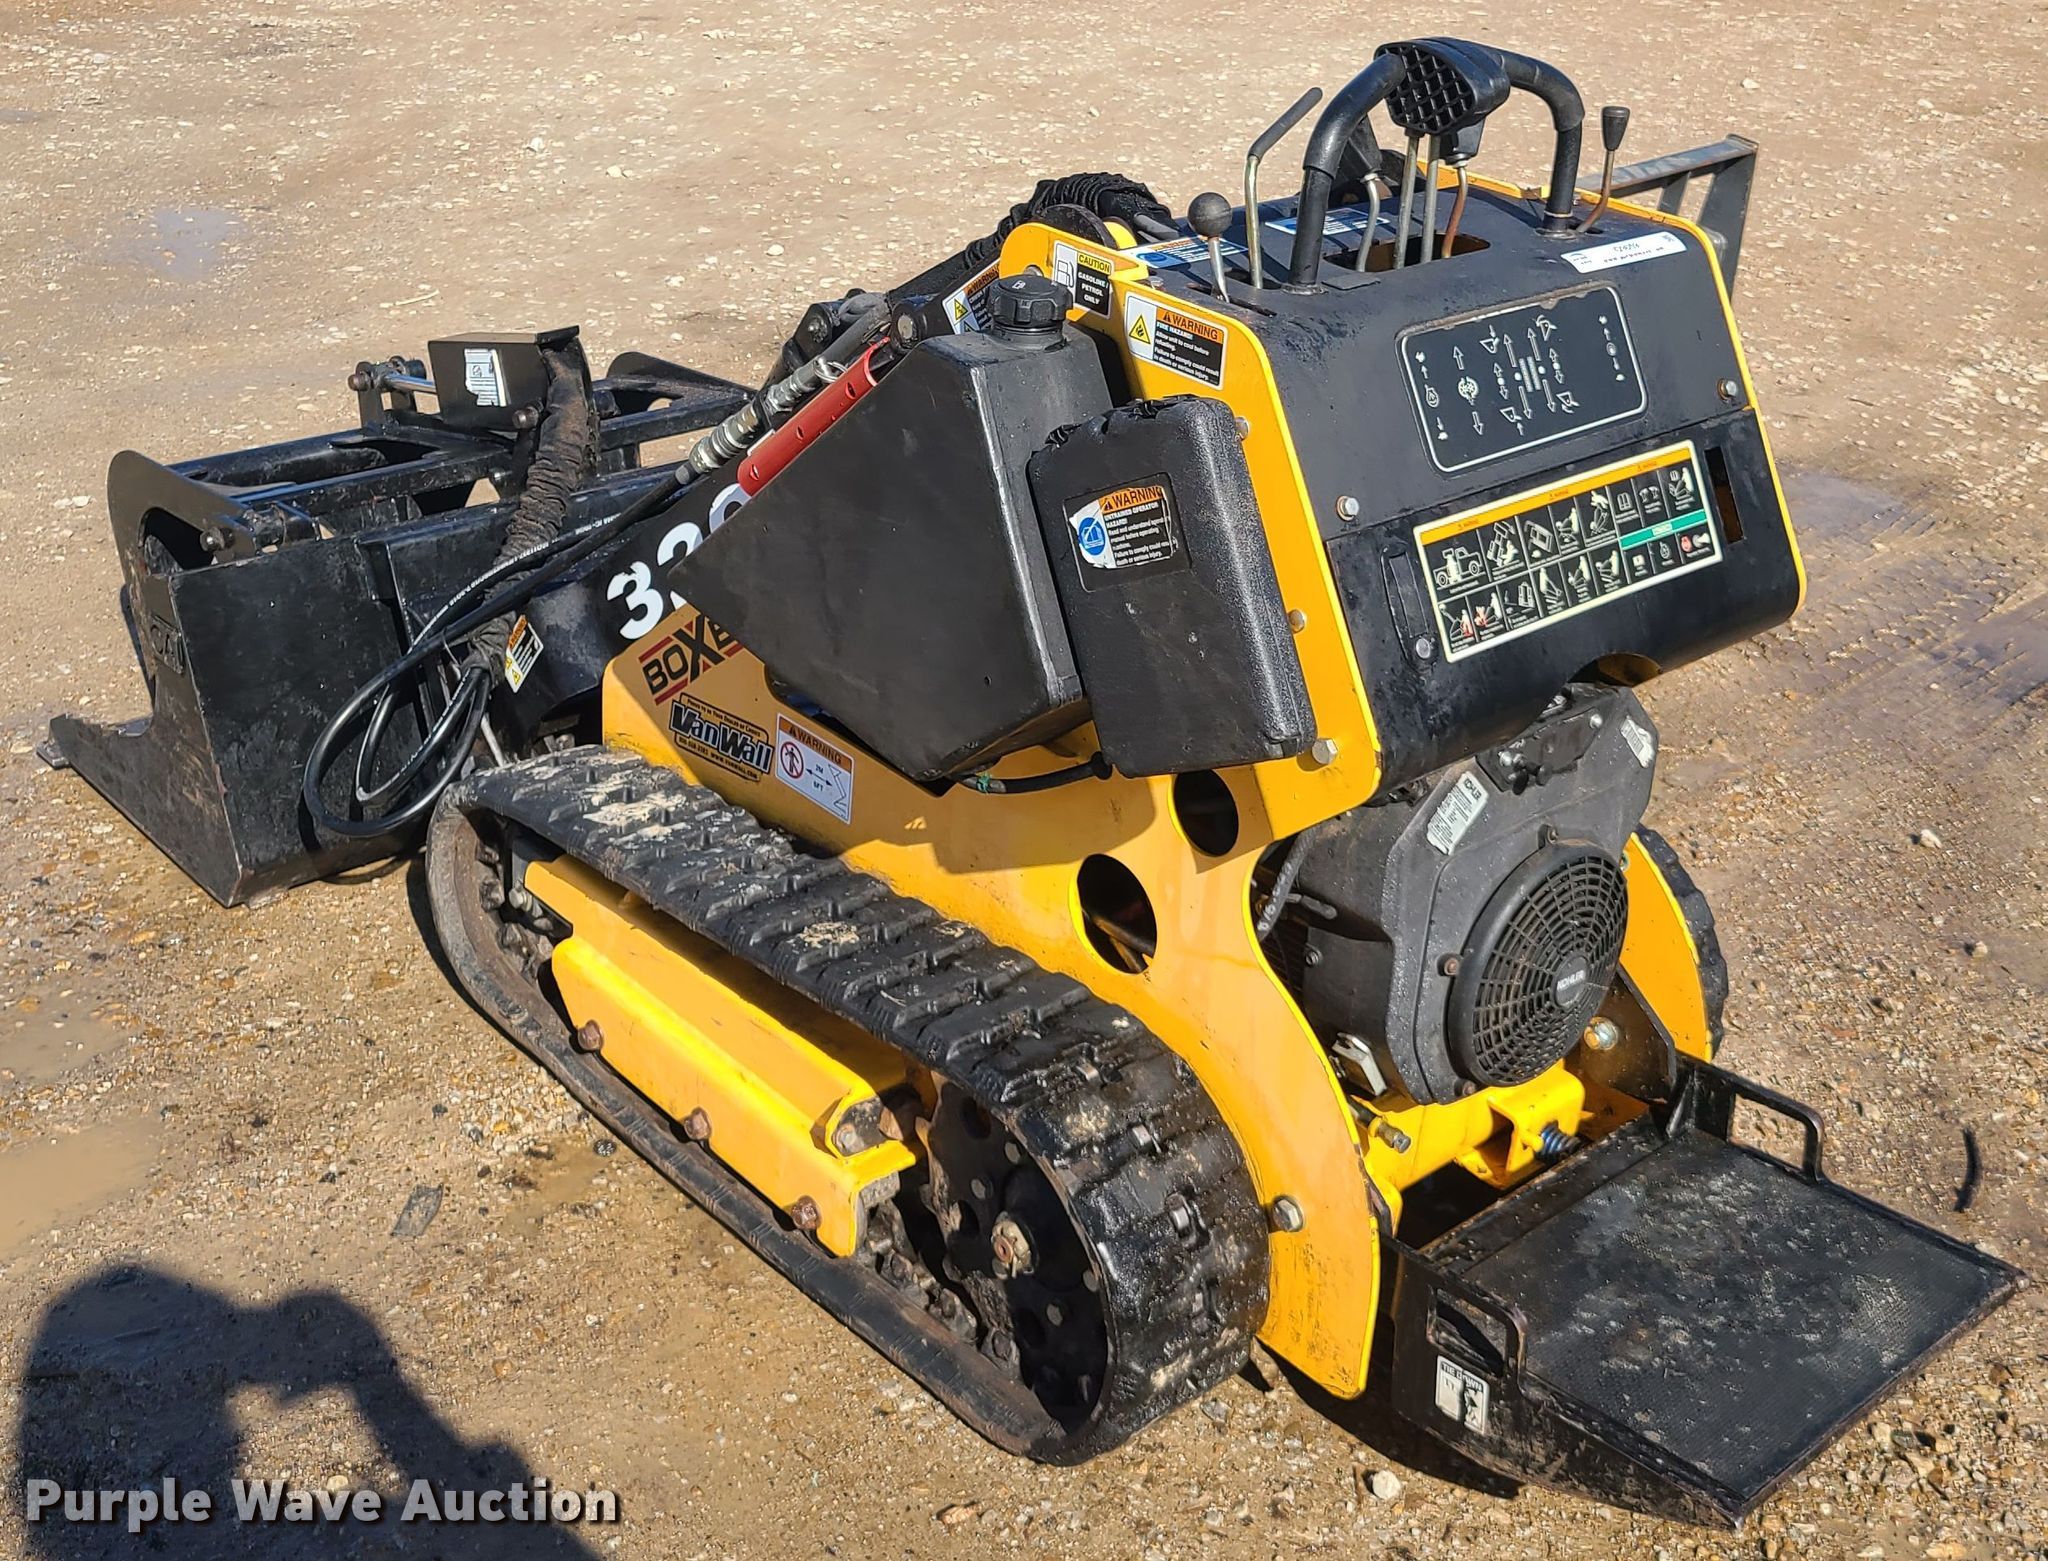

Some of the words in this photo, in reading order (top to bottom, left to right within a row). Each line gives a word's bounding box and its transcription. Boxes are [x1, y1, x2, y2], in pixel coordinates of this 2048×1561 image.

[1078, 254, 1110, 273] CAUTION
[1078, 272, 1105, 287] GASOLINE
[1082, 283, 1103, 296] PETROL
[1084, 294, 1100, 305] ONLY
[1172, 314, 1219, 340] WARNING
[642, 614, 738, 695] BOXE
[670, 700, 775, 775] VanWall
[798, 729, 841, 764] WARNING
